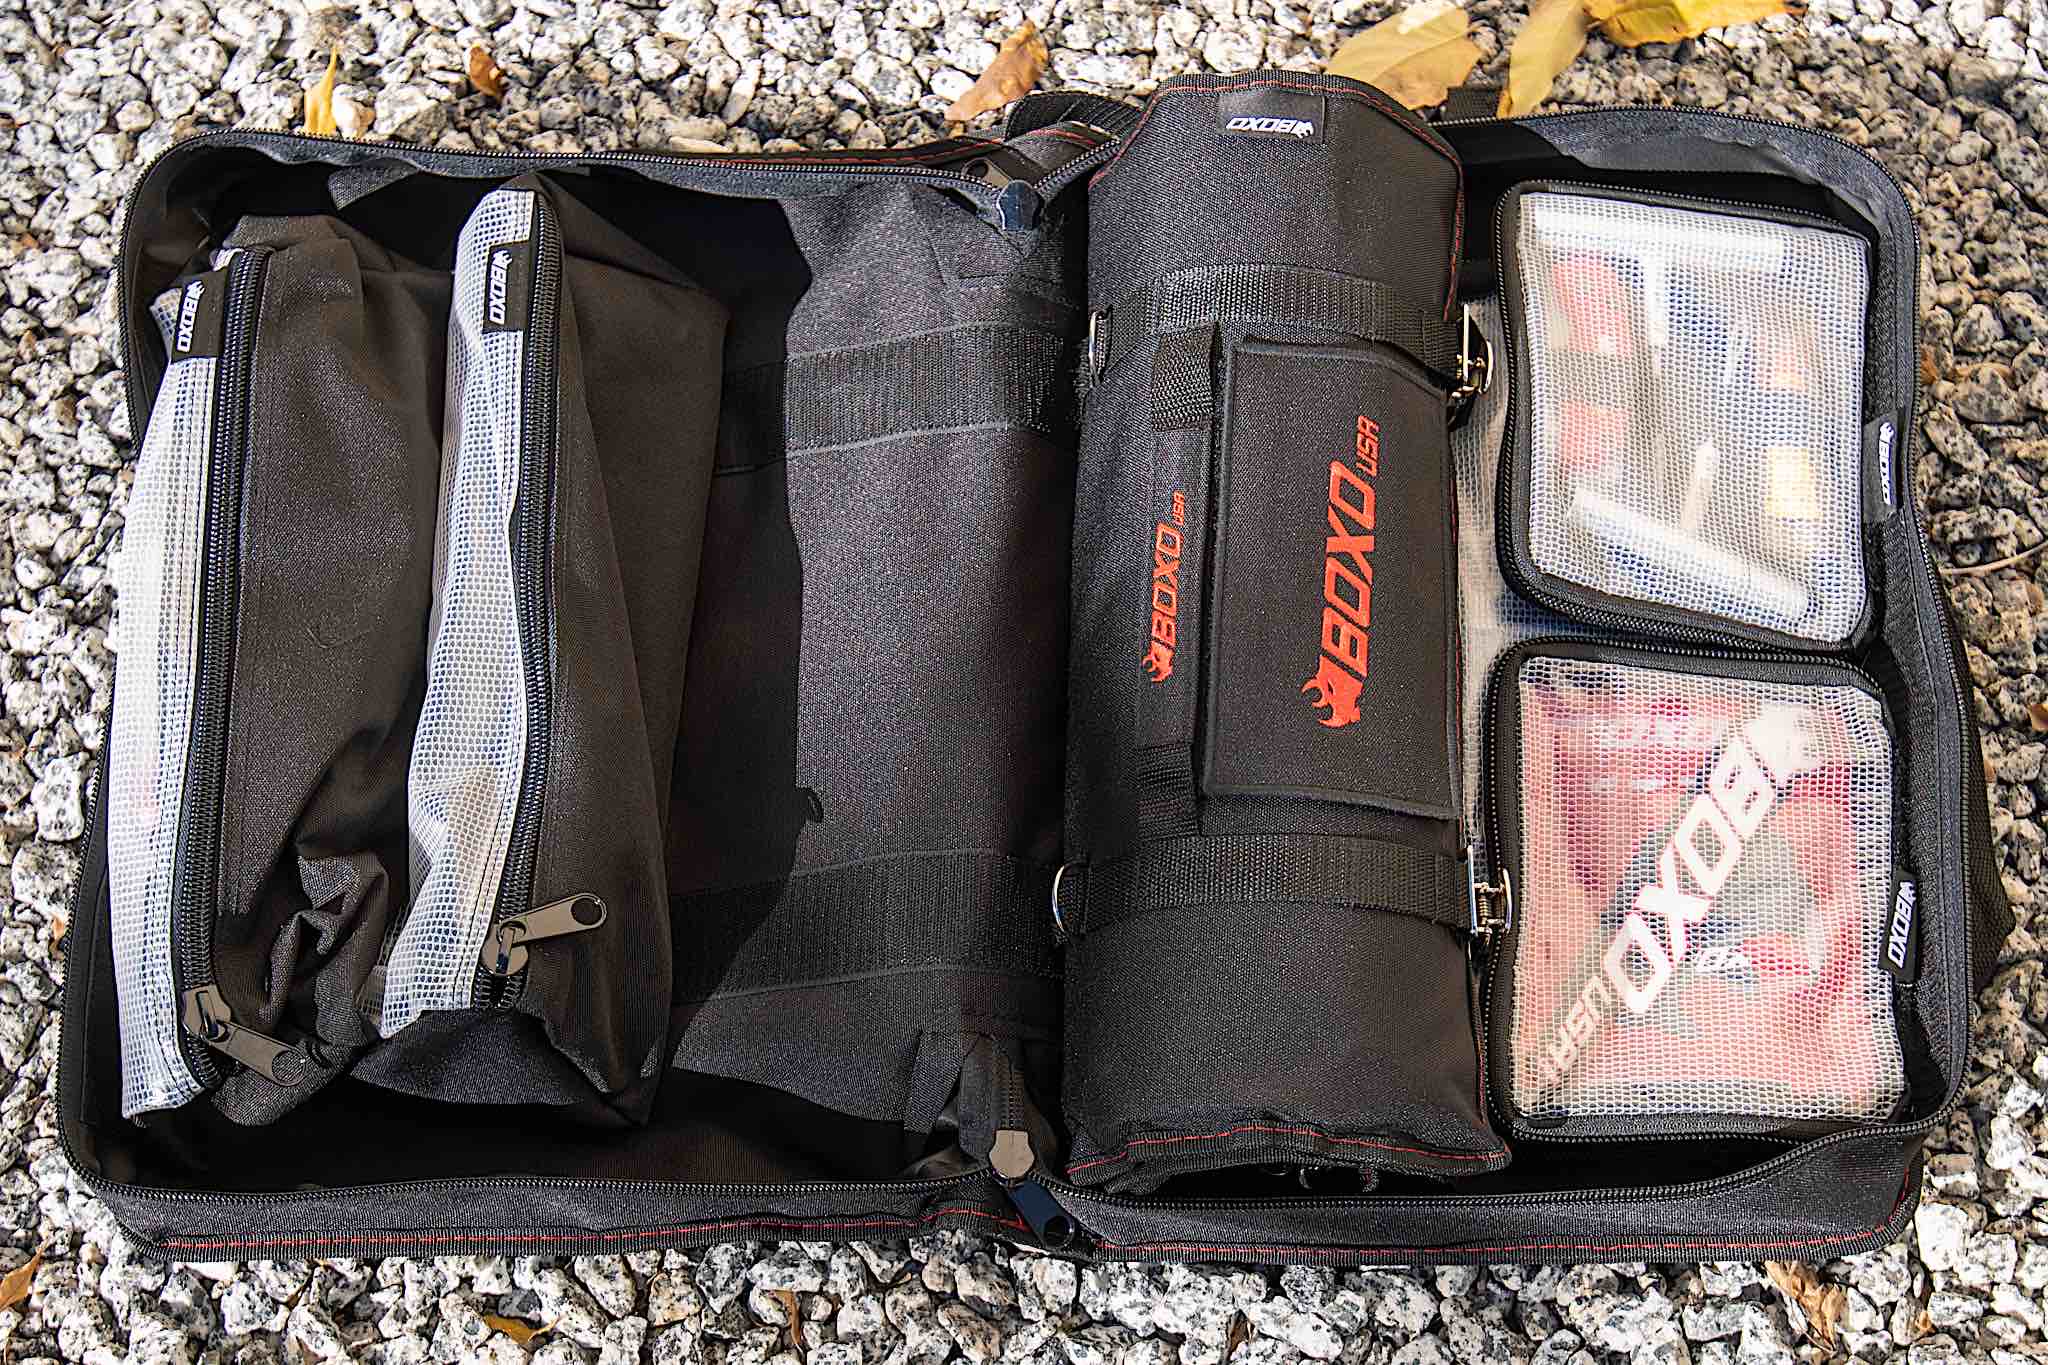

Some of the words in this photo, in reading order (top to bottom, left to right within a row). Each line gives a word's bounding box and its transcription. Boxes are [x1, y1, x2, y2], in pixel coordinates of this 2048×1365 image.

[1226, 117, 1296, 134] BOXO
[177, 296, 199, 352] BOXO
[489, 264, 507, 325] BOXO
[1151, 523, 1183, 648] BOXO
[1172, 490, 1185, 526] USA
[1321, 460, 1377, 677] BOXO
[1356, 415, 1381, 477] USA
[1605, 738, 1776, 1014] BOXO
[1887, 894, 1912, 969] BOXO
